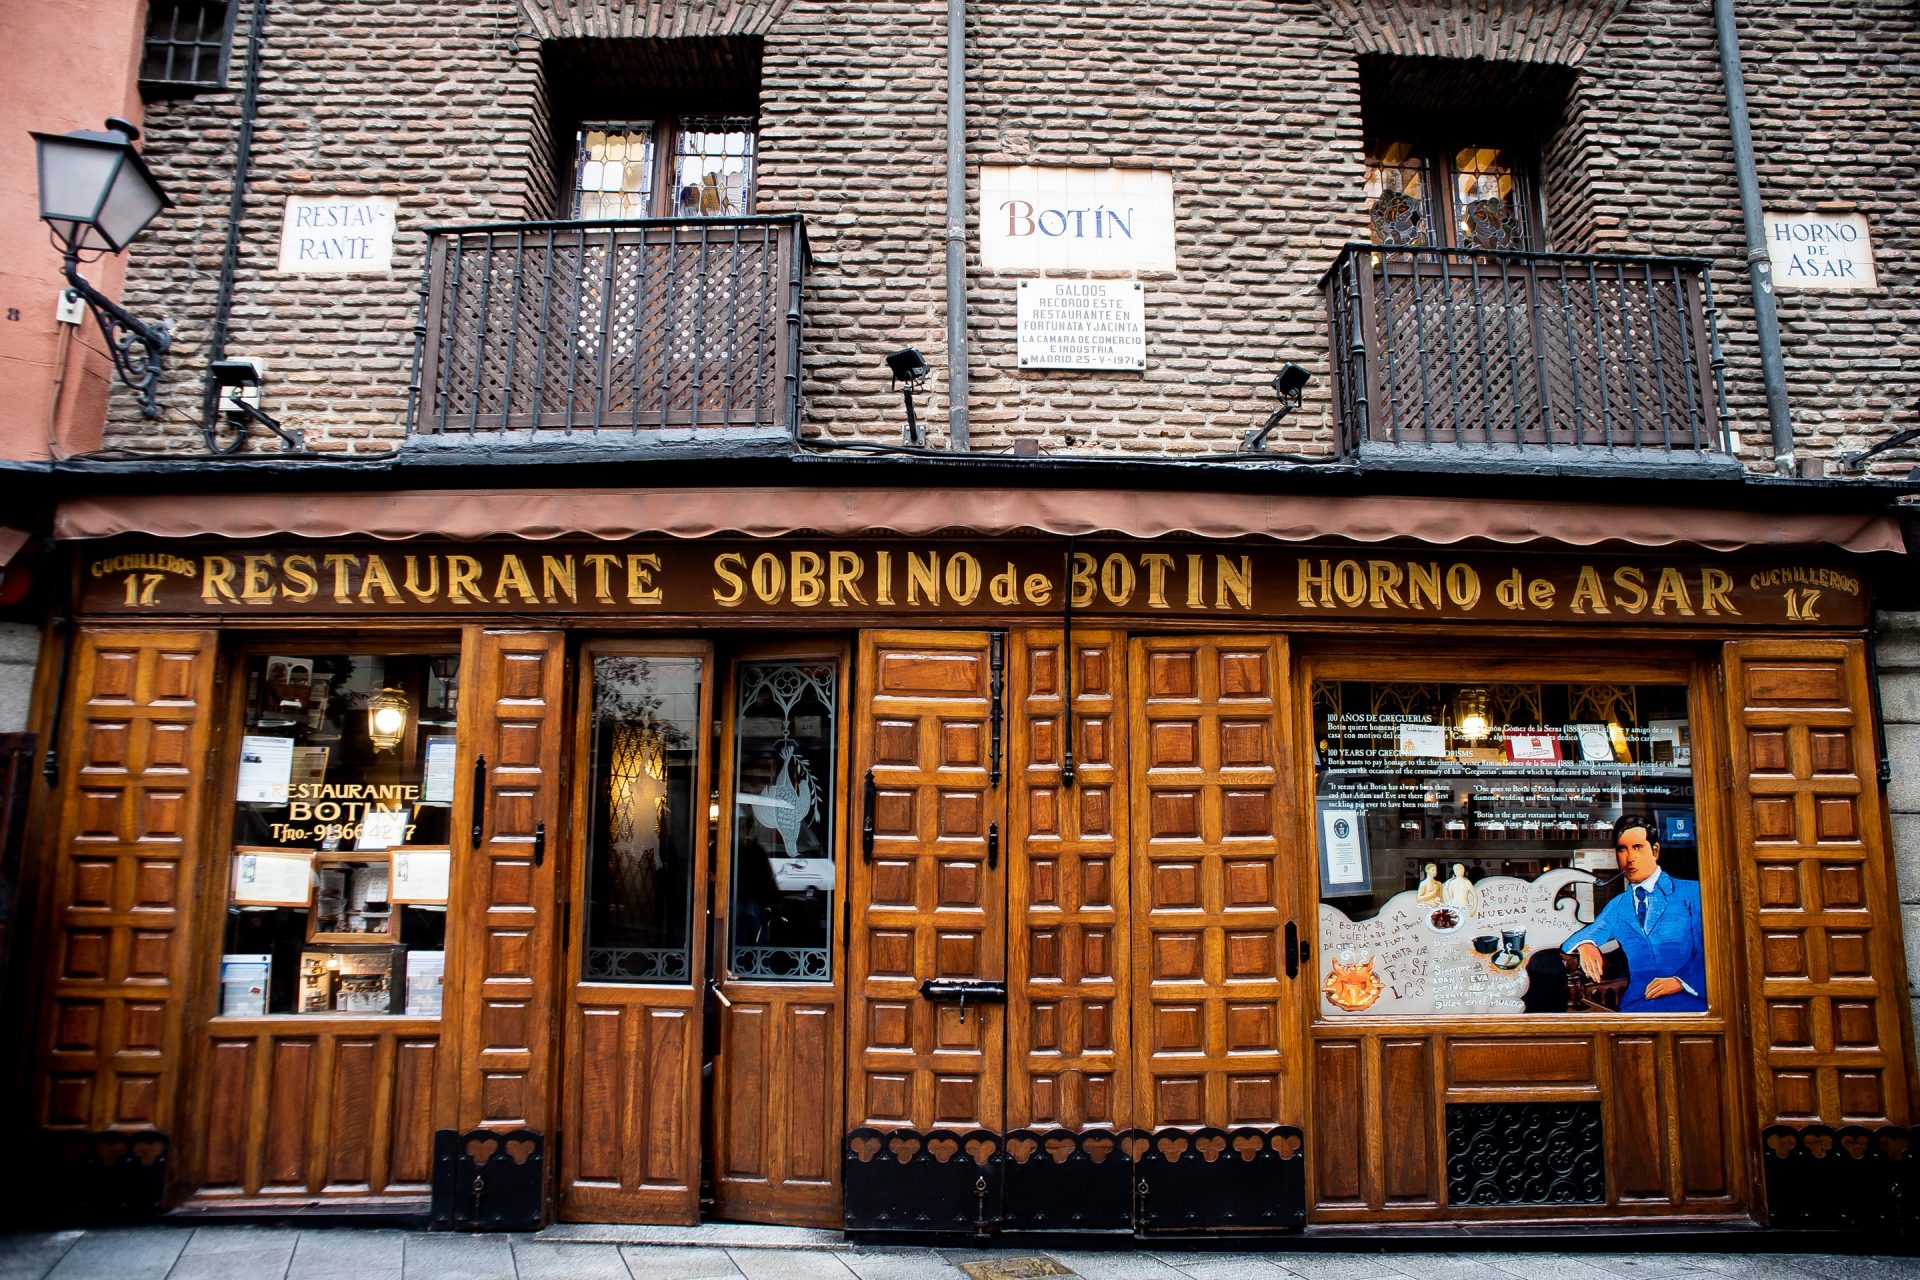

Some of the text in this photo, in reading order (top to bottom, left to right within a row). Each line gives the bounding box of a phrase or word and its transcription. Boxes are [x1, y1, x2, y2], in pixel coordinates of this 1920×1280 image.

[1774, 223, 1857, 243] HORNO
[299, 236, 374, 260] RANTE
[1807, 245, 1830, 256] DE
[1787, 253, 1857, 279] ASAR
[1092, 299, 1123, 309] ESTE
[1033, 310, 1131, 321] RESTAURANTE EN
[1086, 322, 1092, 332] Y
[1022, 335, 1035, 344] LA
[1078, 335, 1090, 345] DE
[1092, 336, 1142, 345] COMERCIO
[1050, 345, 1056, 353] E
[91, 553, 197, 579] CUCHILLEROS
[200, 549, 1743, 617] RESTAURANTE SOBRINO de BOTIN HORNO de ASAR
[1750, 566, 1860, 597] CUCHILLEROS
[1327, 714, 1338, 722] 100
[1340, 712, 1364, 722] AÑOS
[1348, 724, 1368, 733] quiere
[1632, 726, 1650, 734] amigo
[1384, 758, 1408, 767] homage
[272, 783, 420, 800] RESTAURANTE
[1399, 784, 1418, 792] always
[1581, 786, 1600, 794] golden
[1499, 794, 1524, 802] wedding
[1328, 800, 1354, 810] suckling
[1355, 801, 1364, 810] pig
[289, 802, 403, 822] BOTIN
[1576, 812, 1590, 820] they
[1477, 906, 1527, 919] NUEVAS
[1470, 974, 1488, 983] EVA
